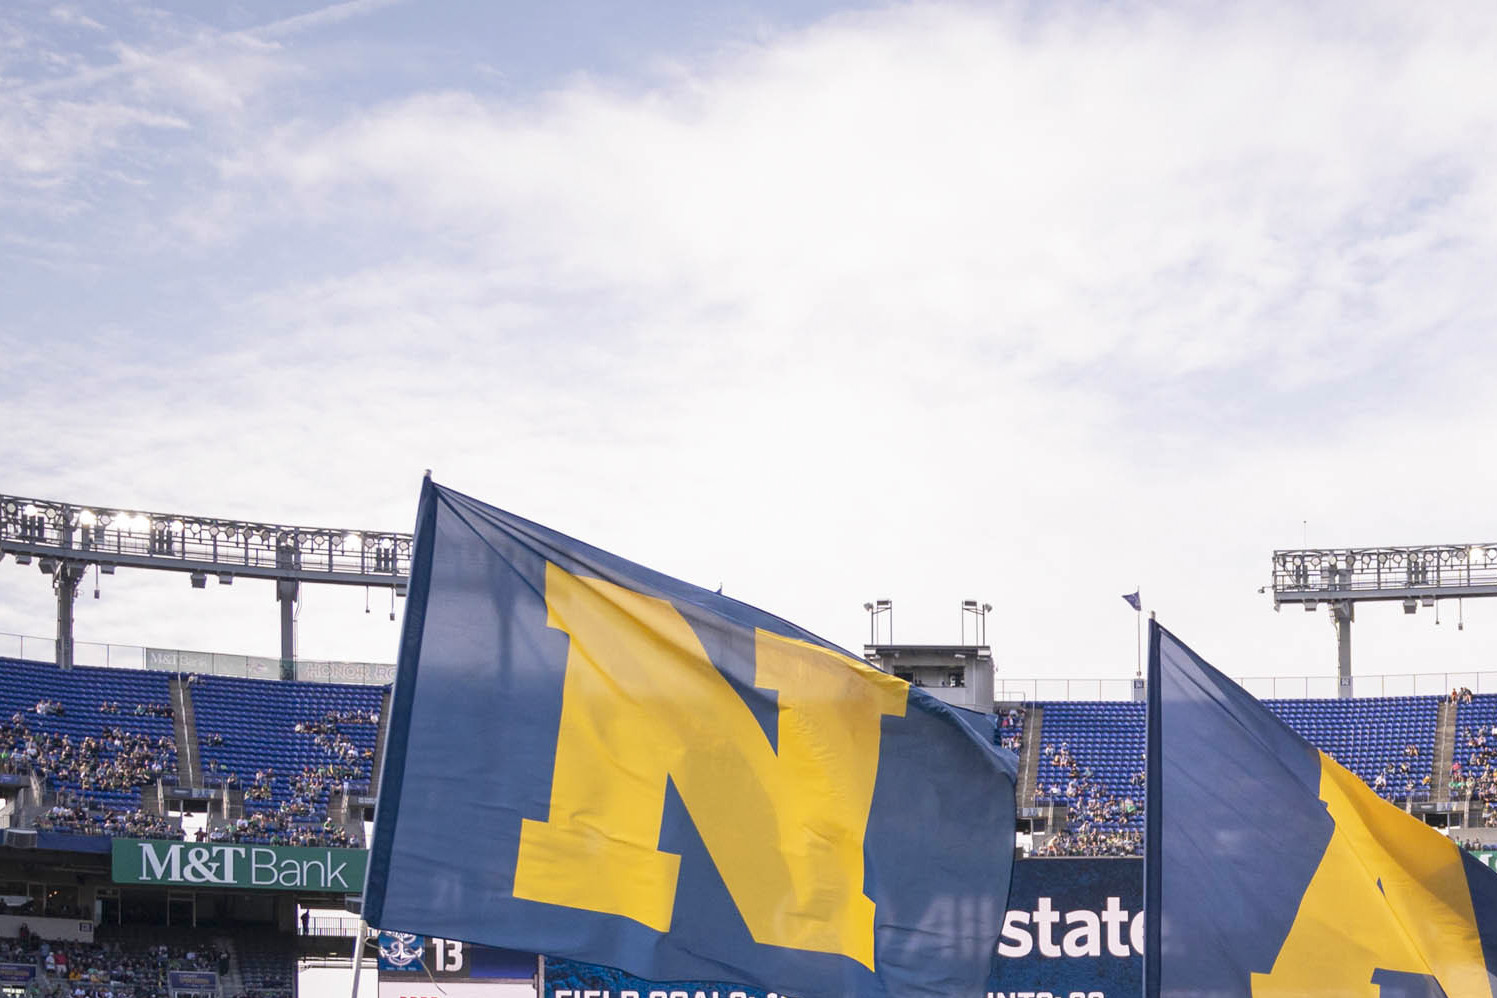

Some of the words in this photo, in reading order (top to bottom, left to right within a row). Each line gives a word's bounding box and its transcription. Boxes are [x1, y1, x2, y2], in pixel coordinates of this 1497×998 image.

[511, 559, 910, 970] N
[138, 843, 246, 884] M&T
[251, 848, 349, 888] Bank
[431, 938, 463, 972] 13
